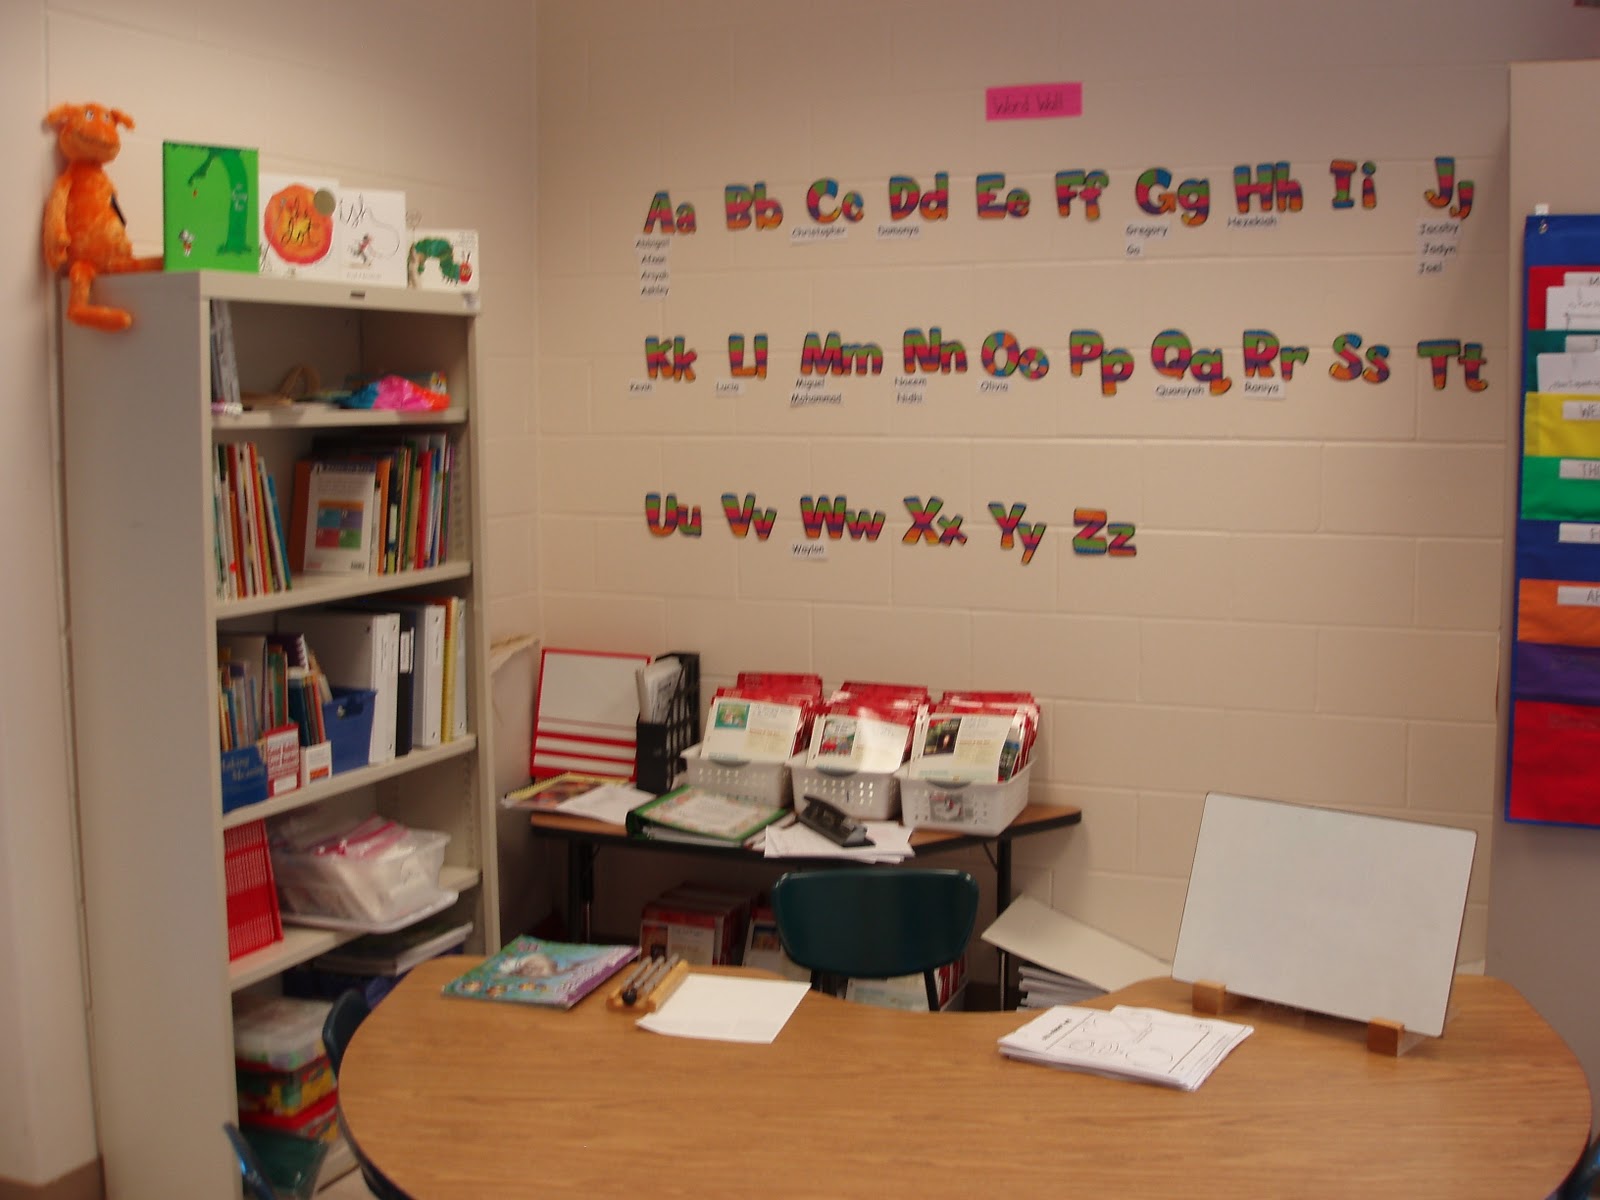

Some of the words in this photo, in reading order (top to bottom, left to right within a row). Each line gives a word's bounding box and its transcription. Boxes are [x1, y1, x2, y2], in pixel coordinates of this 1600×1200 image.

[643, 191, 697, 234] Aa
[725, 182, 783, 230] Bb
[805, 178, 864, 223] Cc
[889, 172, 949, 221] Dd
[976, 172, 1031, 219] Ee
[1055, 170, 1109, 221] Ff
[1135, 167, 1210, 226] Gg
[1233, 161, 1303, 213] Hh
[1330, 159, 1377, 209] Ii
[1424, 157, 1474, 219] Jj
[1125, 224, 1168, 237] Gregory
[645, 335, 698, 382] Kk
[728, 333, 768, 380] Ll
[801, 331, 883, 376] Mm
[903, 327, 968, 374] Nn
[981, 331, 1050, 381] Oo
[1069, 329, 1135, 397] Pp
[1151, 329, 1232, 395] Qq
[1242, 329, 1309, 381] Rr
[1329, 333, 1390, 384] Ss
[1417, 339, 1488, 392] Tt
[645, 492, 702, 537] Uu
[721, 493, 777, 541] Vv
[800, 495, 886, 541] Ww
[902, 496, 968, 546] Xx
[987, 502, 1047, 566] Yy
[1072, 508, 1137, 556] Zz
